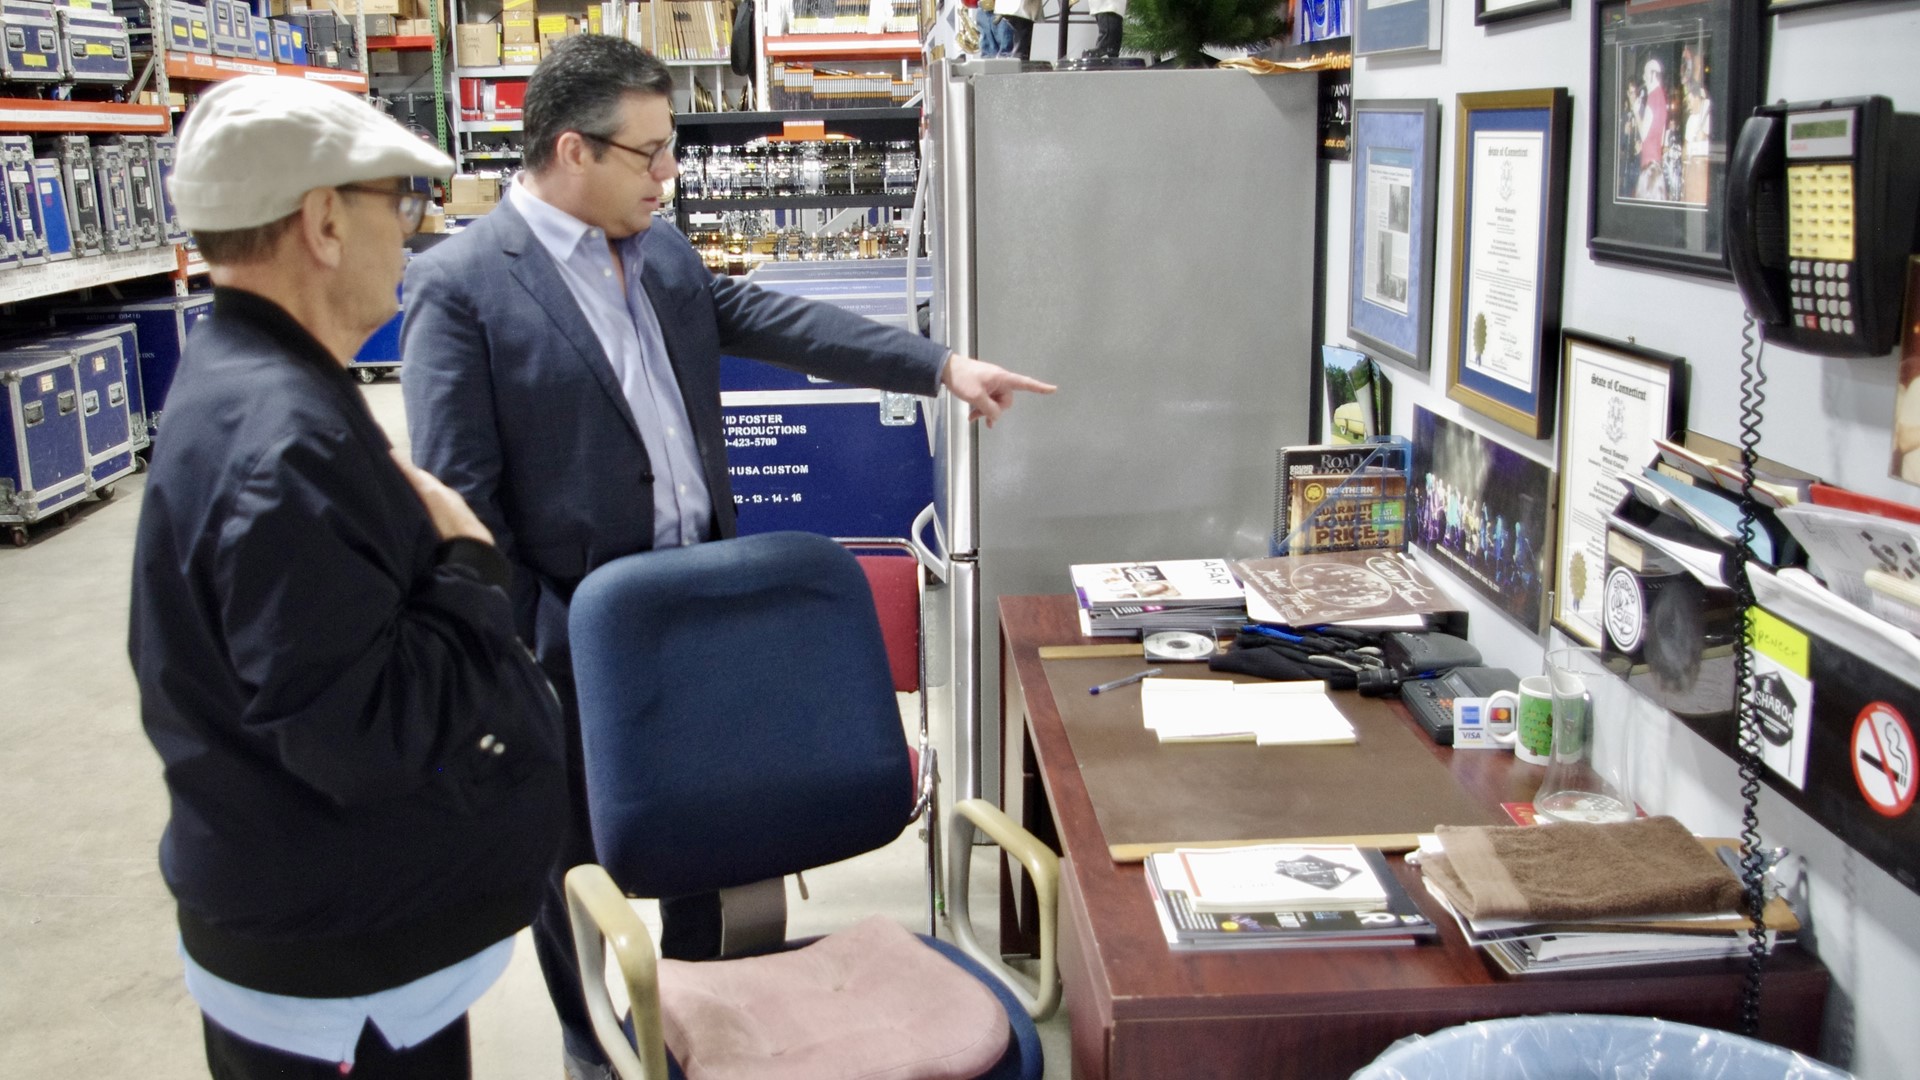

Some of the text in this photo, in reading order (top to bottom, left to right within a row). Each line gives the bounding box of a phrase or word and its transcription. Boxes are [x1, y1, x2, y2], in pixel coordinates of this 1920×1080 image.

[1591, 373, 1646, 400] State of Connecticut
[739, 414, 783, 424] FOSTER
[728, 425, 807, 436] PRODUCTIONS
[737, 466, 760, 475] USA
[762, 464, 809, 475] CUSTOM
[1326, 486, 1376, 494] NORTHERN
[733, 494, 743, 504] 12
[752, 494, 762, 503] 13
[771, 493, 782, 503] 14
[1201, 560, 1230, 585] AFAR
[1755, 690, 1794, 728] SHABOO
[1462, 731, 1481, 739] VISA
